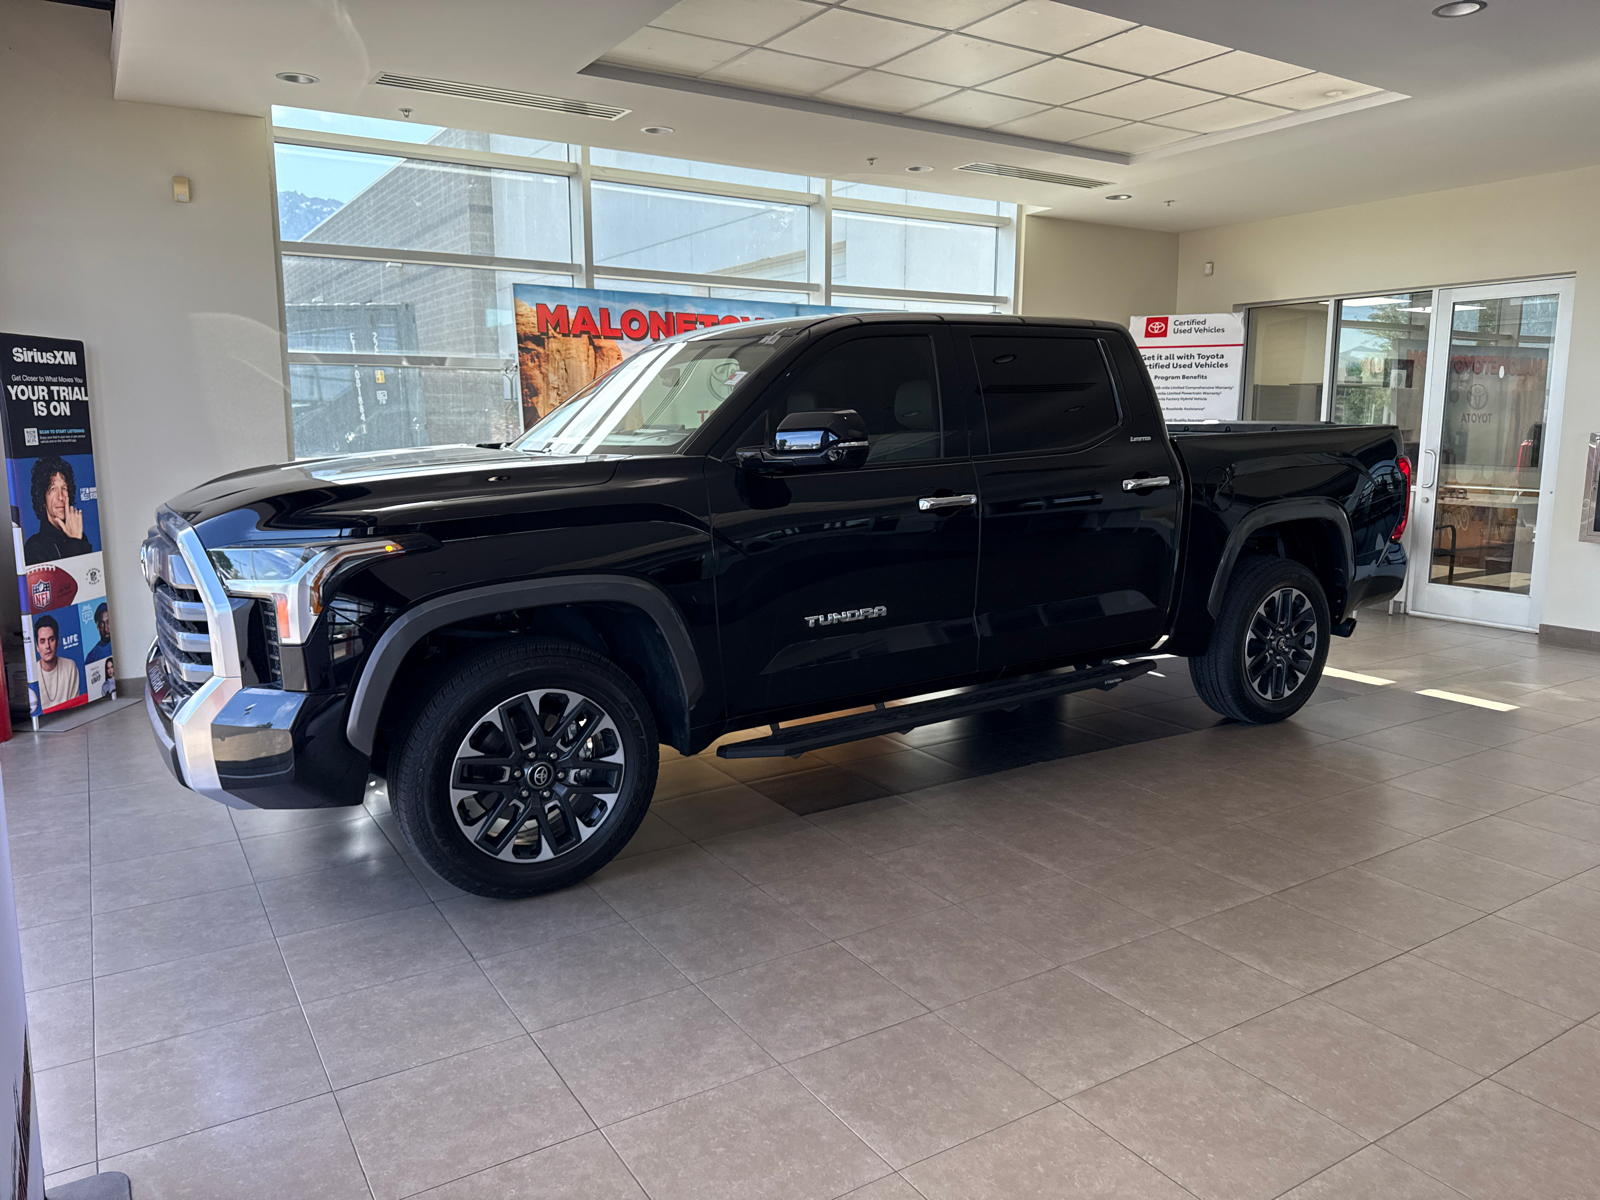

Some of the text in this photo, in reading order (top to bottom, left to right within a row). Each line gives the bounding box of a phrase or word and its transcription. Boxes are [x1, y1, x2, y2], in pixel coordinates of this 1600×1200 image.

[12, 347, 77, 365] SiriusXM
[1197, 353, 1224, 361] Toyota
[7, 385, 88, 400] YOUR TRIAL
[33, 402, 71, 416] IS ON
[35, 592, 49, 606] NFL
[804, 605, 887, 628] TUNDRA
[62, 634, 79, 646] LIFE
